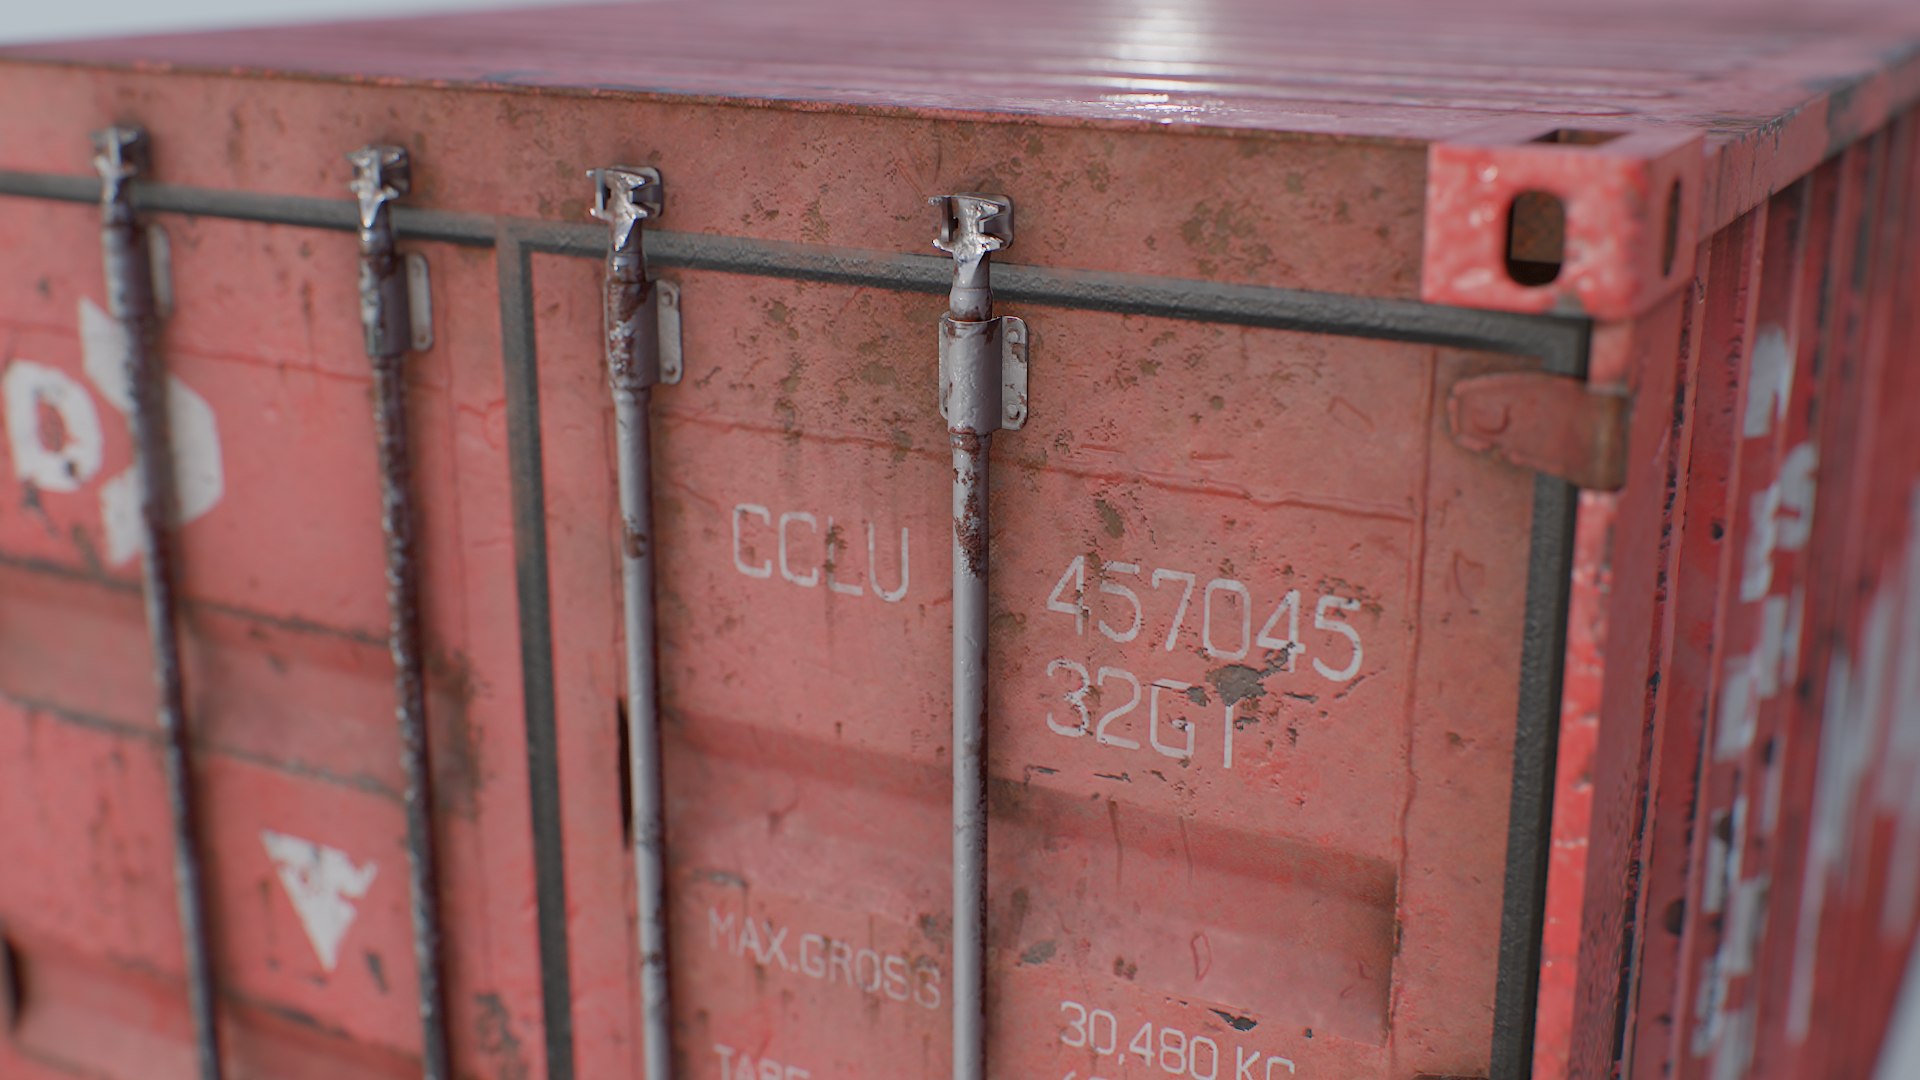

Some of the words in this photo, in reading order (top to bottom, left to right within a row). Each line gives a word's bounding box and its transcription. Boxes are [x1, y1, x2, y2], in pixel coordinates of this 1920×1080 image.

[732, 503, 910, 603] CCLU
[1045, 554, 1365, 682] 457045
[1060, 1000, 1220, 1080] 30,480
